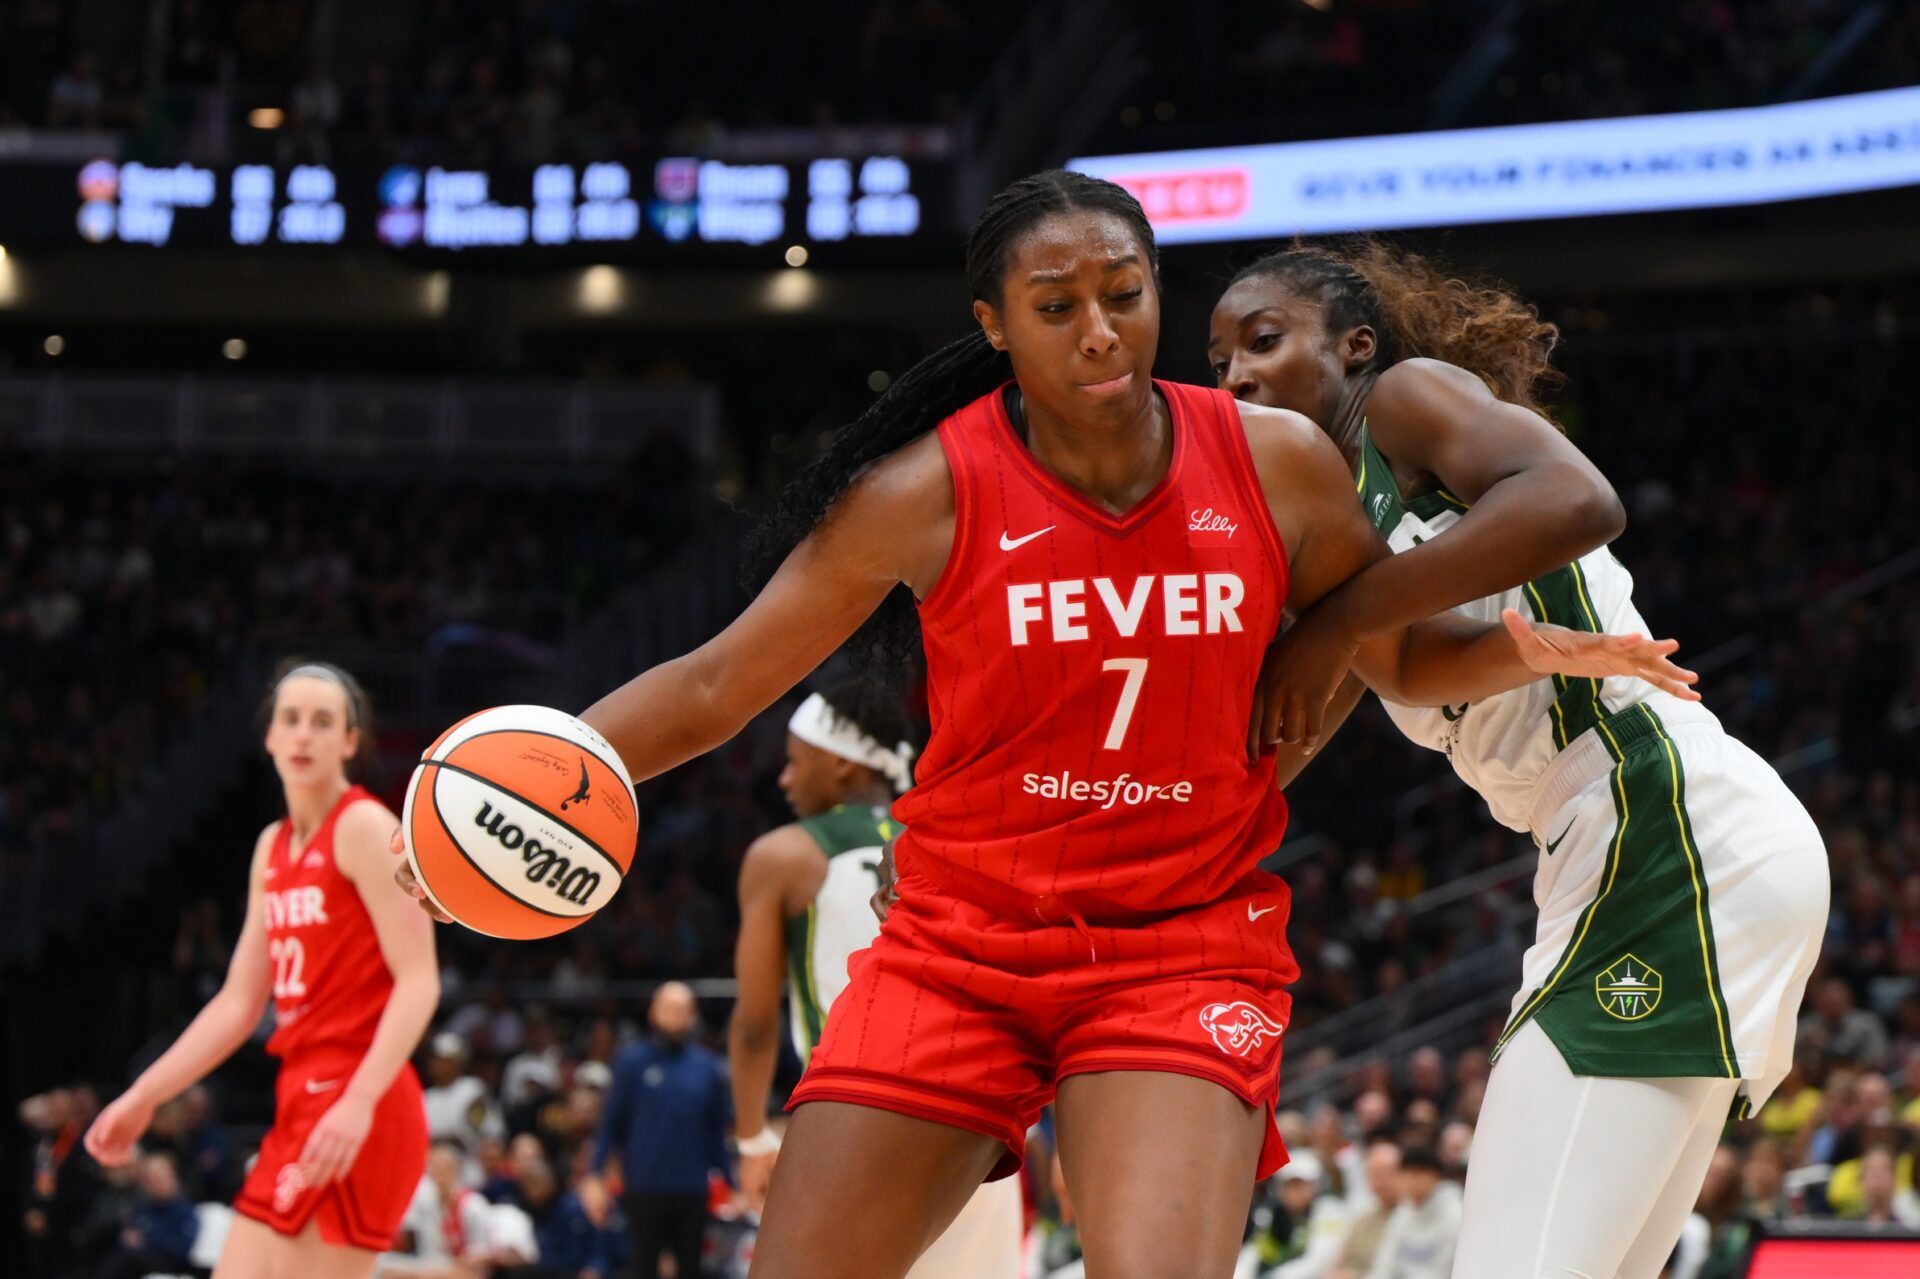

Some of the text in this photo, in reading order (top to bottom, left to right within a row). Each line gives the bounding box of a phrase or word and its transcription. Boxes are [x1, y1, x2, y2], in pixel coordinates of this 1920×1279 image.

[1188, 507, 1239, 539] Lilly
[1007, 572, 1246, 648] FEVER
[1102, 657, 1150, 751] 7
[1022, 770, 1193, 809] salesforce
[474, 800, 601, 906] Wilson
